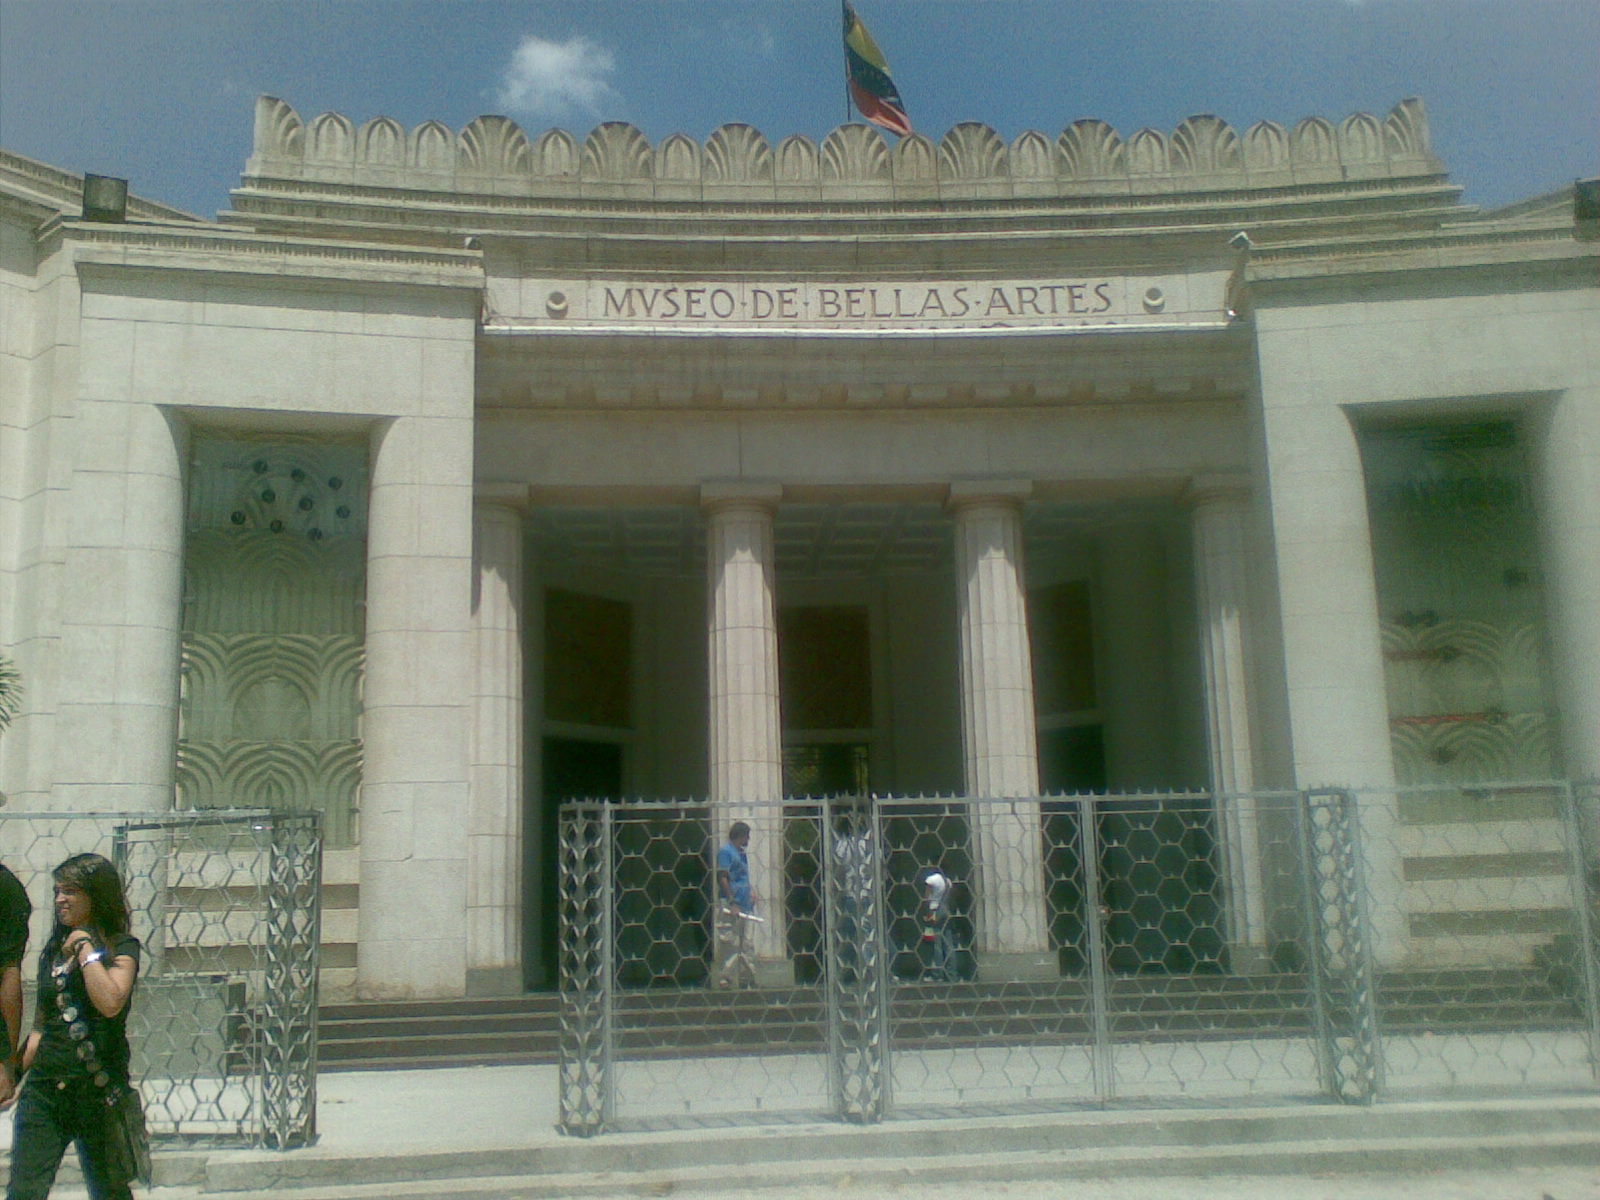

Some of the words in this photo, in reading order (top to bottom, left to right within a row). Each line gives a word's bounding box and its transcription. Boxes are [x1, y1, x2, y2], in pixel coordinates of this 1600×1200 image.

[604, 287, 735, 318] MVSEO
[752, 287, 799, 318] DE
[819, 287, 970, 318] BELLAS
[984, 283, 1113, 316] ARTES
